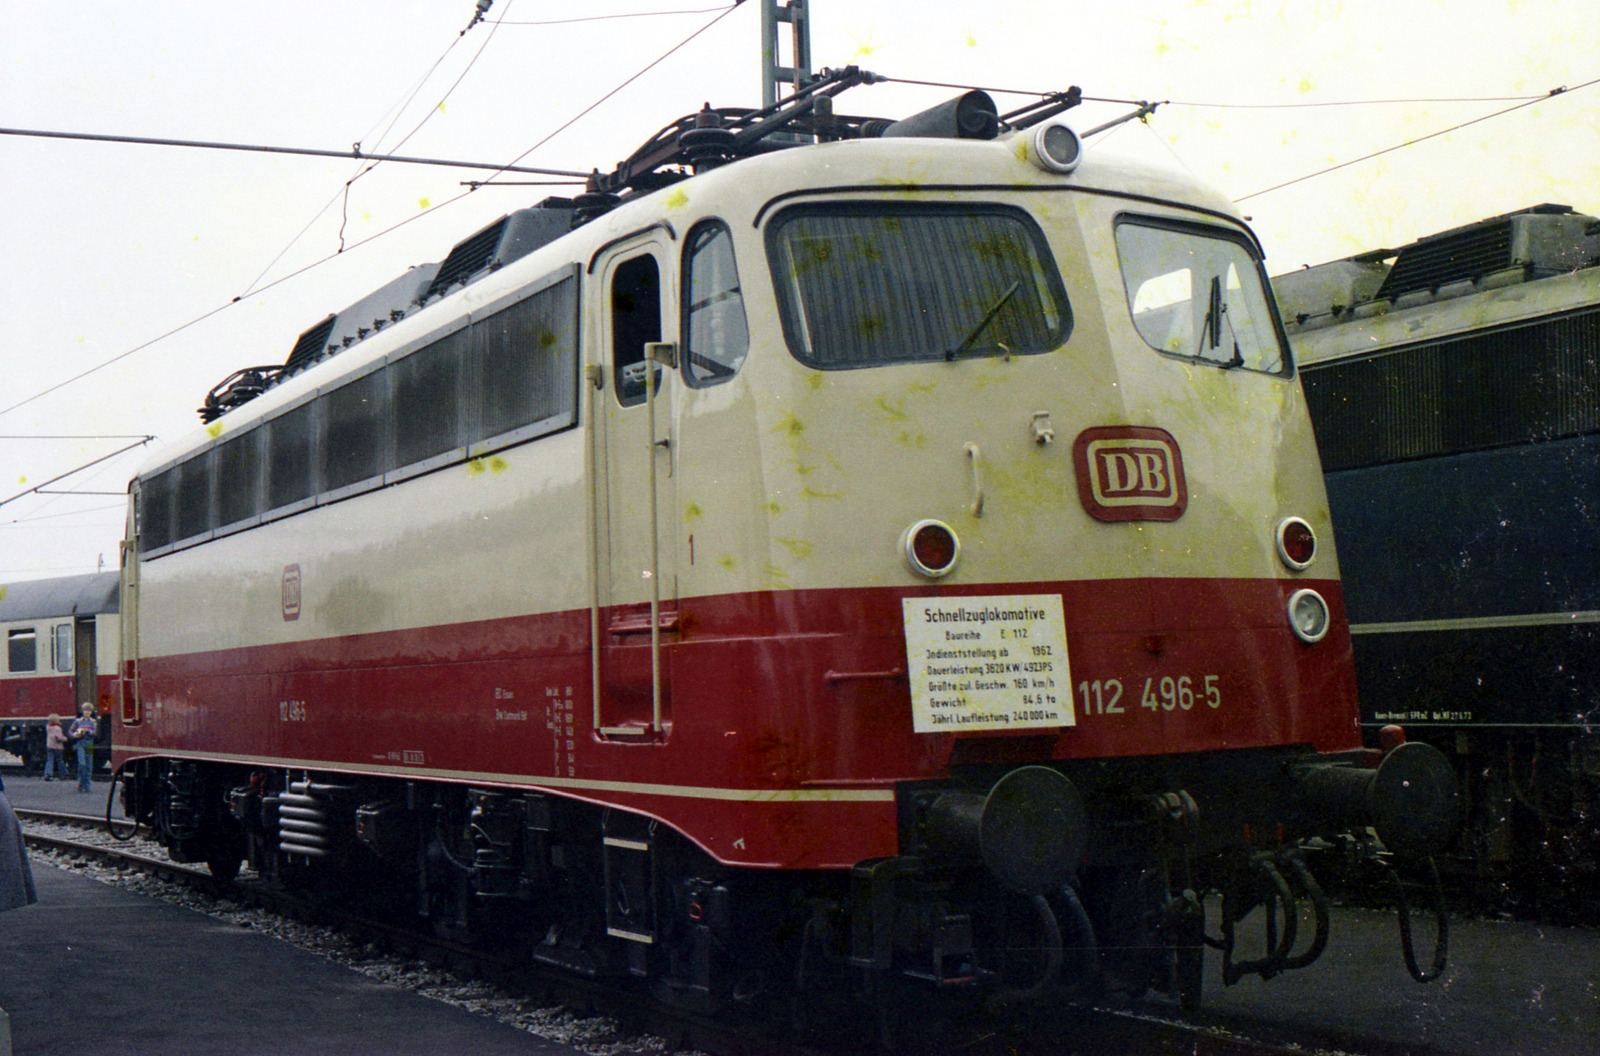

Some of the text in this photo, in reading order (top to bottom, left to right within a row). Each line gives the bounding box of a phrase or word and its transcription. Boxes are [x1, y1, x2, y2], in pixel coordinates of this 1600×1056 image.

[1100, 453, 1167, 493] DB
[924, 607, 1046, 624] Schnellzuglokomotive
[945, 628, 1028, 641] Baureihe E 112
[999, 647, 1009, 657] ab
[1031, 645, 1053, 656] 1962
[926, 665, 984, 677] Dauerleistung
[928, 680, 957, 692] Größte
[1013, 678, 1028, 689] 160
[1032, 676, 1055, 689] km/h
[1078, 675, 1221, 715] 112 496-5
[929, 697, 967, 708] Gewicht
[956, 712, 1009, 724] Laufleistung
